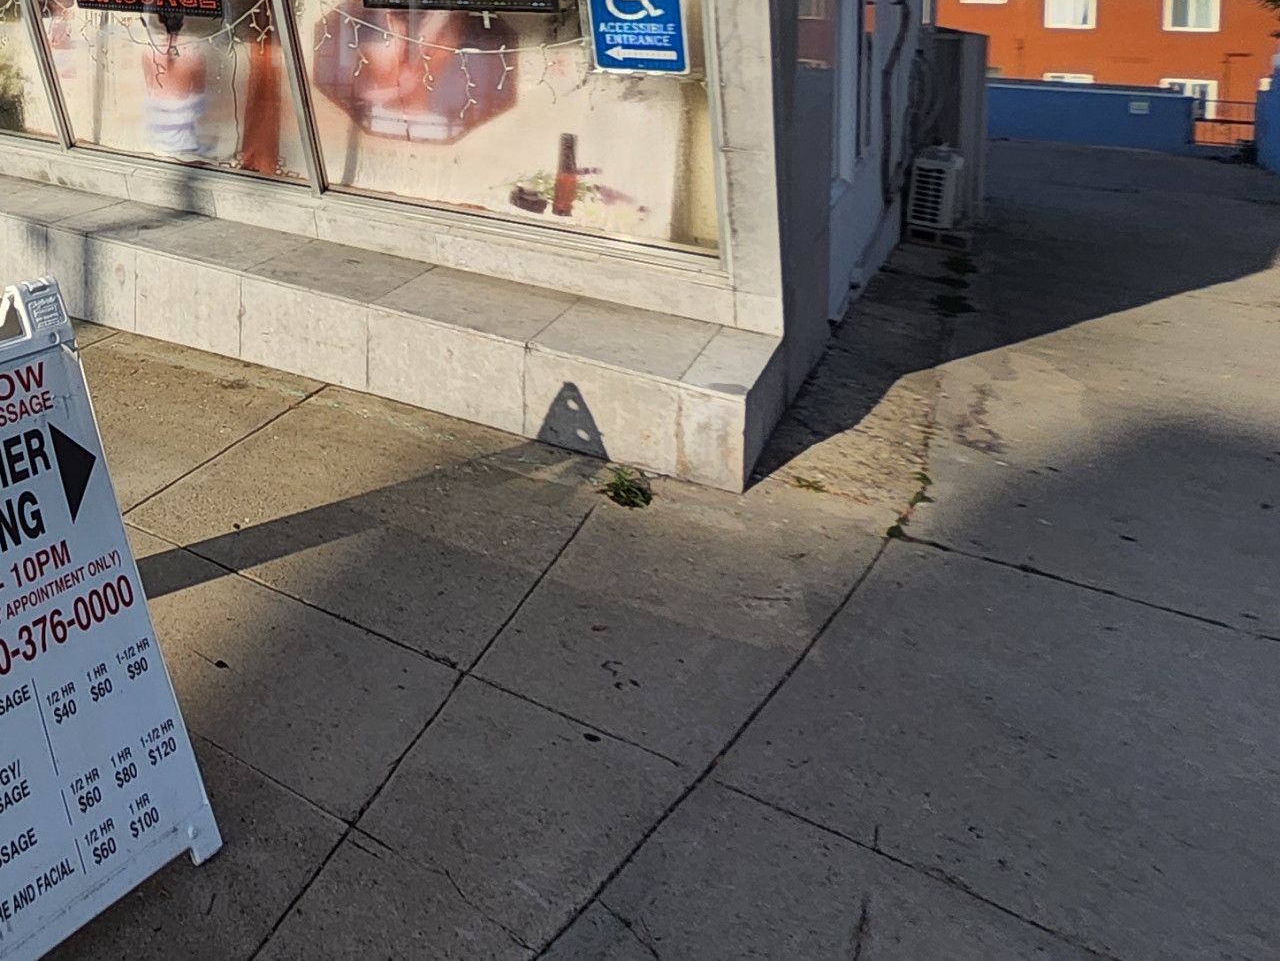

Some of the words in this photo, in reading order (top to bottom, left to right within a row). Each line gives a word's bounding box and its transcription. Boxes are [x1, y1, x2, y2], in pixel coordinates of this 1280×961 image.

[599, 22, 677, 34] ACCESSIBLE
[605, 34, 672, 46] ENTRANCE
[6, 567, 85, 620] APPOINTMENT
[86, 550, 123, 577] ONLY)
[10, 540, 71, 588] 10PM
[46, 690, 60, 706] 1/2
[61, 682, 76, 698] HR
[93, 663, 108, 679] HR
[136, 638, 150, 653] HR
[54, 699, 77, 725] $40
[90, 678, 113, 702] $60
[127, 657, 148, 680] $90
[70, 778, 84, 795] 1/2
[85, 768, 100, 786] HR
[117, 747, 132, 764] HR
[160, 719, 175, 734] HR
[78, 786, 102, 813] $60
[115, 762, 138, 788] $80
[148, 737, 176, 766] $120
[84, 829, 99, 846] 1/2
[100, 818, 115, 836] HR
[135, 793, 150, 811] HR
[92, 837, 117, 865] $60
[130, 807, 159, 838] $100
[13, 884, 35, 913] AND
[36, 858, 75, 895] FACIAL
